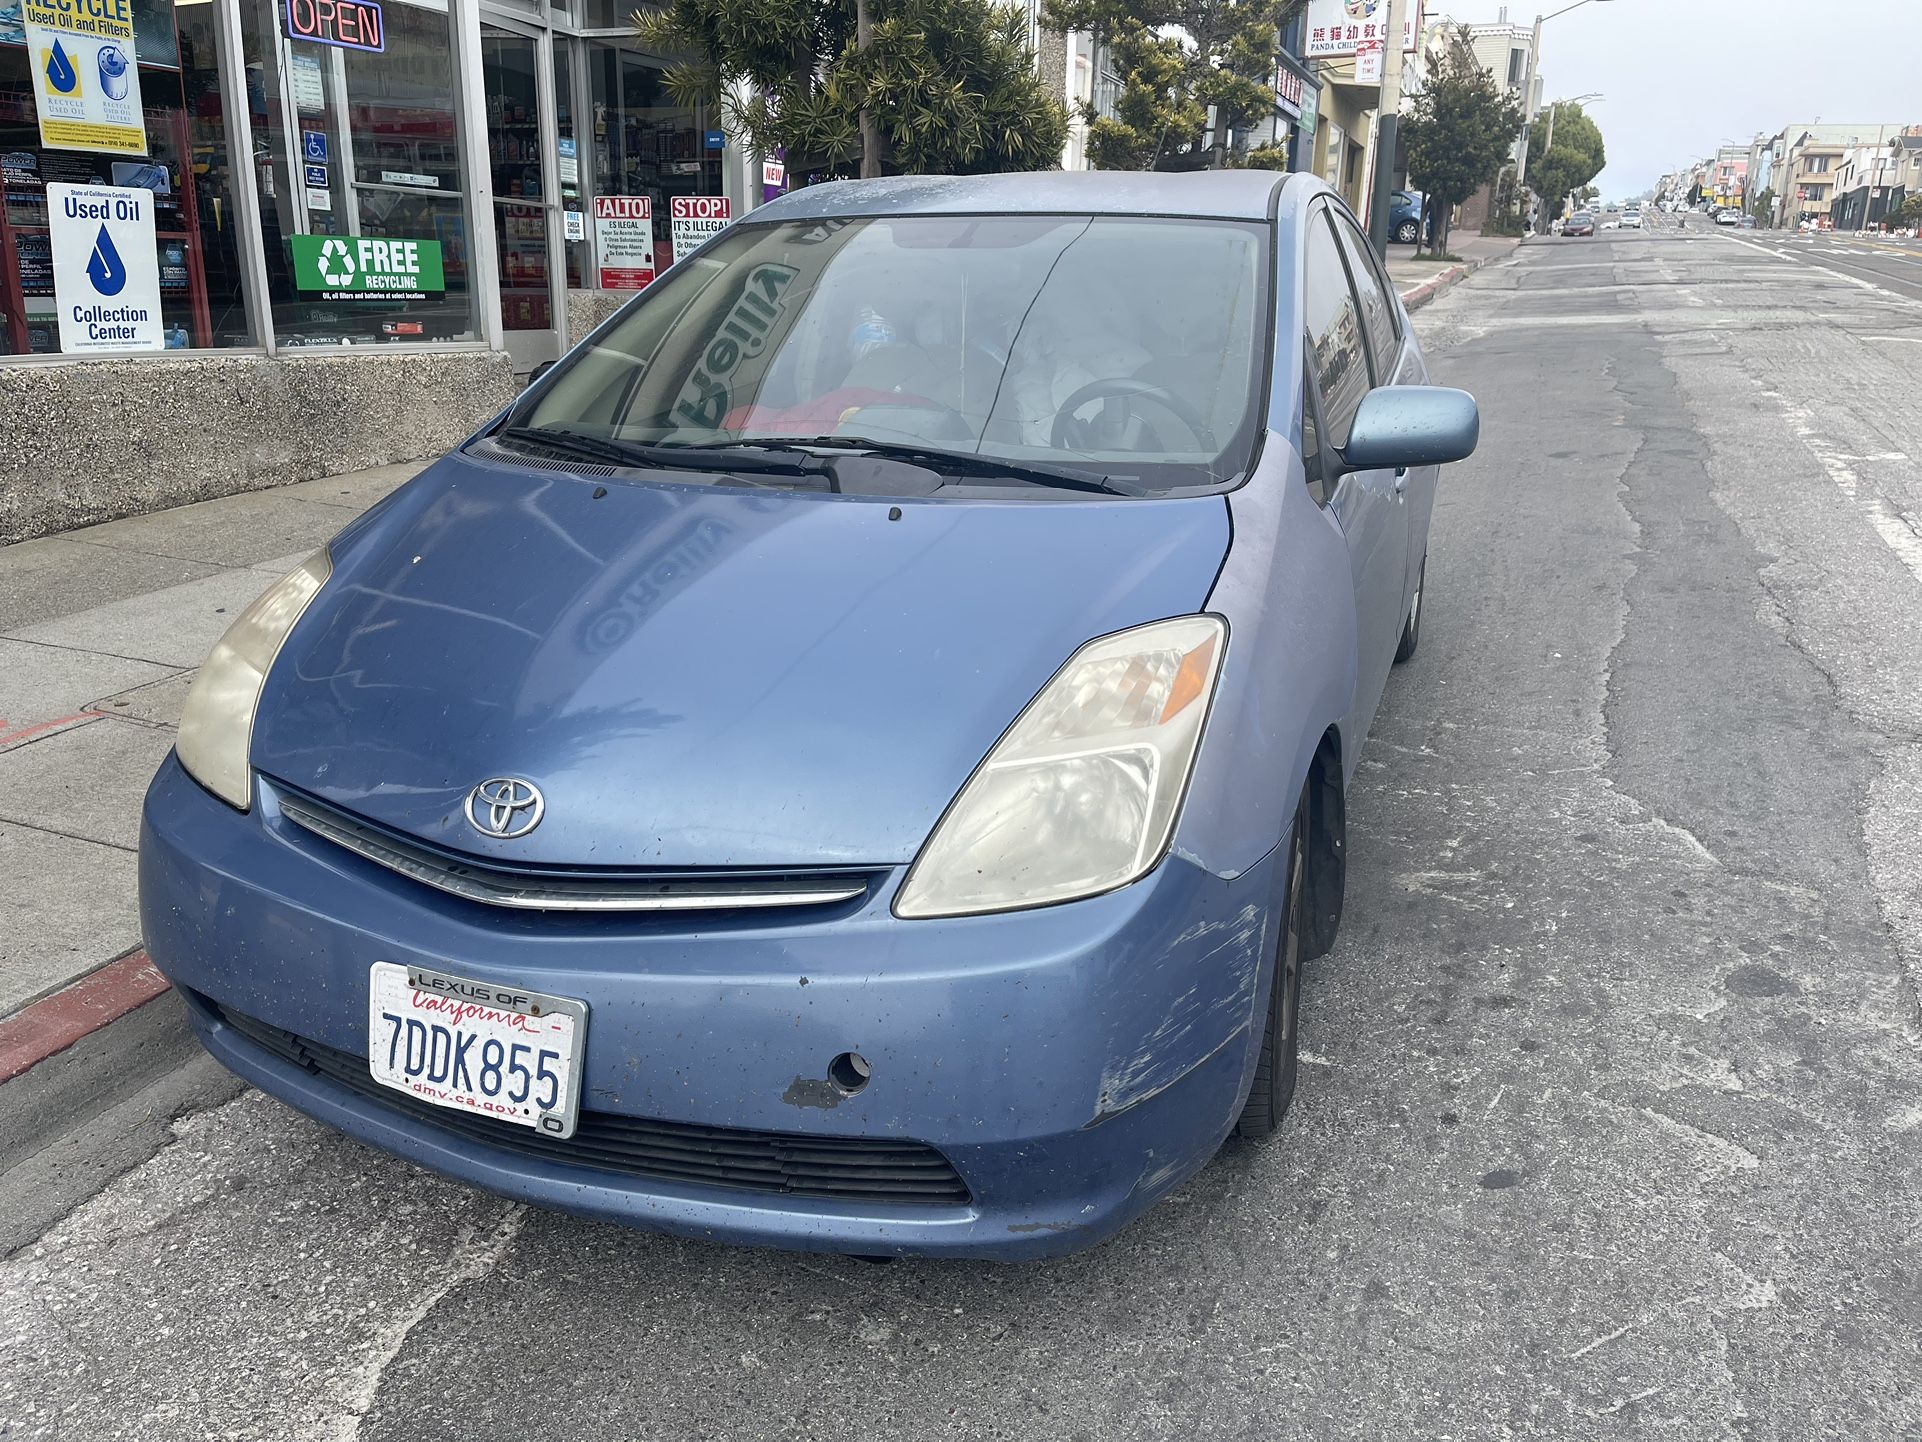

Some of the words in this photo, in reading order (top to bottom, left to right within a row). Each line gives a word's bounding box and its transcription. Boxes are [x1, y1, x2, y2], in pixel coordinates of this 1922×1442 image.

[27, 8, 55, 25] Used
[58, 13, 73, 28] Oil
[76, 18, 96, 32] and
[98, 20, 130, 37] Filters
[292, 0, 379, 45] OPEN
[1311, 43, 1334, 51] PANDA
[48, 98, 85, 108] RECYCLE
[49, 106, 69, 114] USED
[103, 101, 131, 110] RECYCLE
[765, 166, 782, 182] NEW
[89, 190, 111, 198] California
[64, 197, 110, 219] Used
[115, 199, 140, 221] Oil
[596, 198, 649, 218] ¡ALTO!
[674, 198, 727, 218] STOP!
[567, 212, 580, 221] FREE
[608, 221, 617, 229] ES
[618, 221, 639, 229] ILEGAL
[674, 220, 690, 231] IT'S
[682, 232, 706, 240] Abandon
[356, 239, 420, 273] FREE
[365, 275, 418, 289] RECYCLING
[322, 292, 332, 300] Oil,
[73, 305, 148, 323] Collection
[88, 323, 136, 340] Center
[418, 974, 491, 1001] LEXUS
[495, 993, 528, 1006] OF
[412, 989, 540, 1034] California
[382, 1012, 560, 1110] 7DDK855
[413, 1082, 518, 1116] dmv.ca.gov
